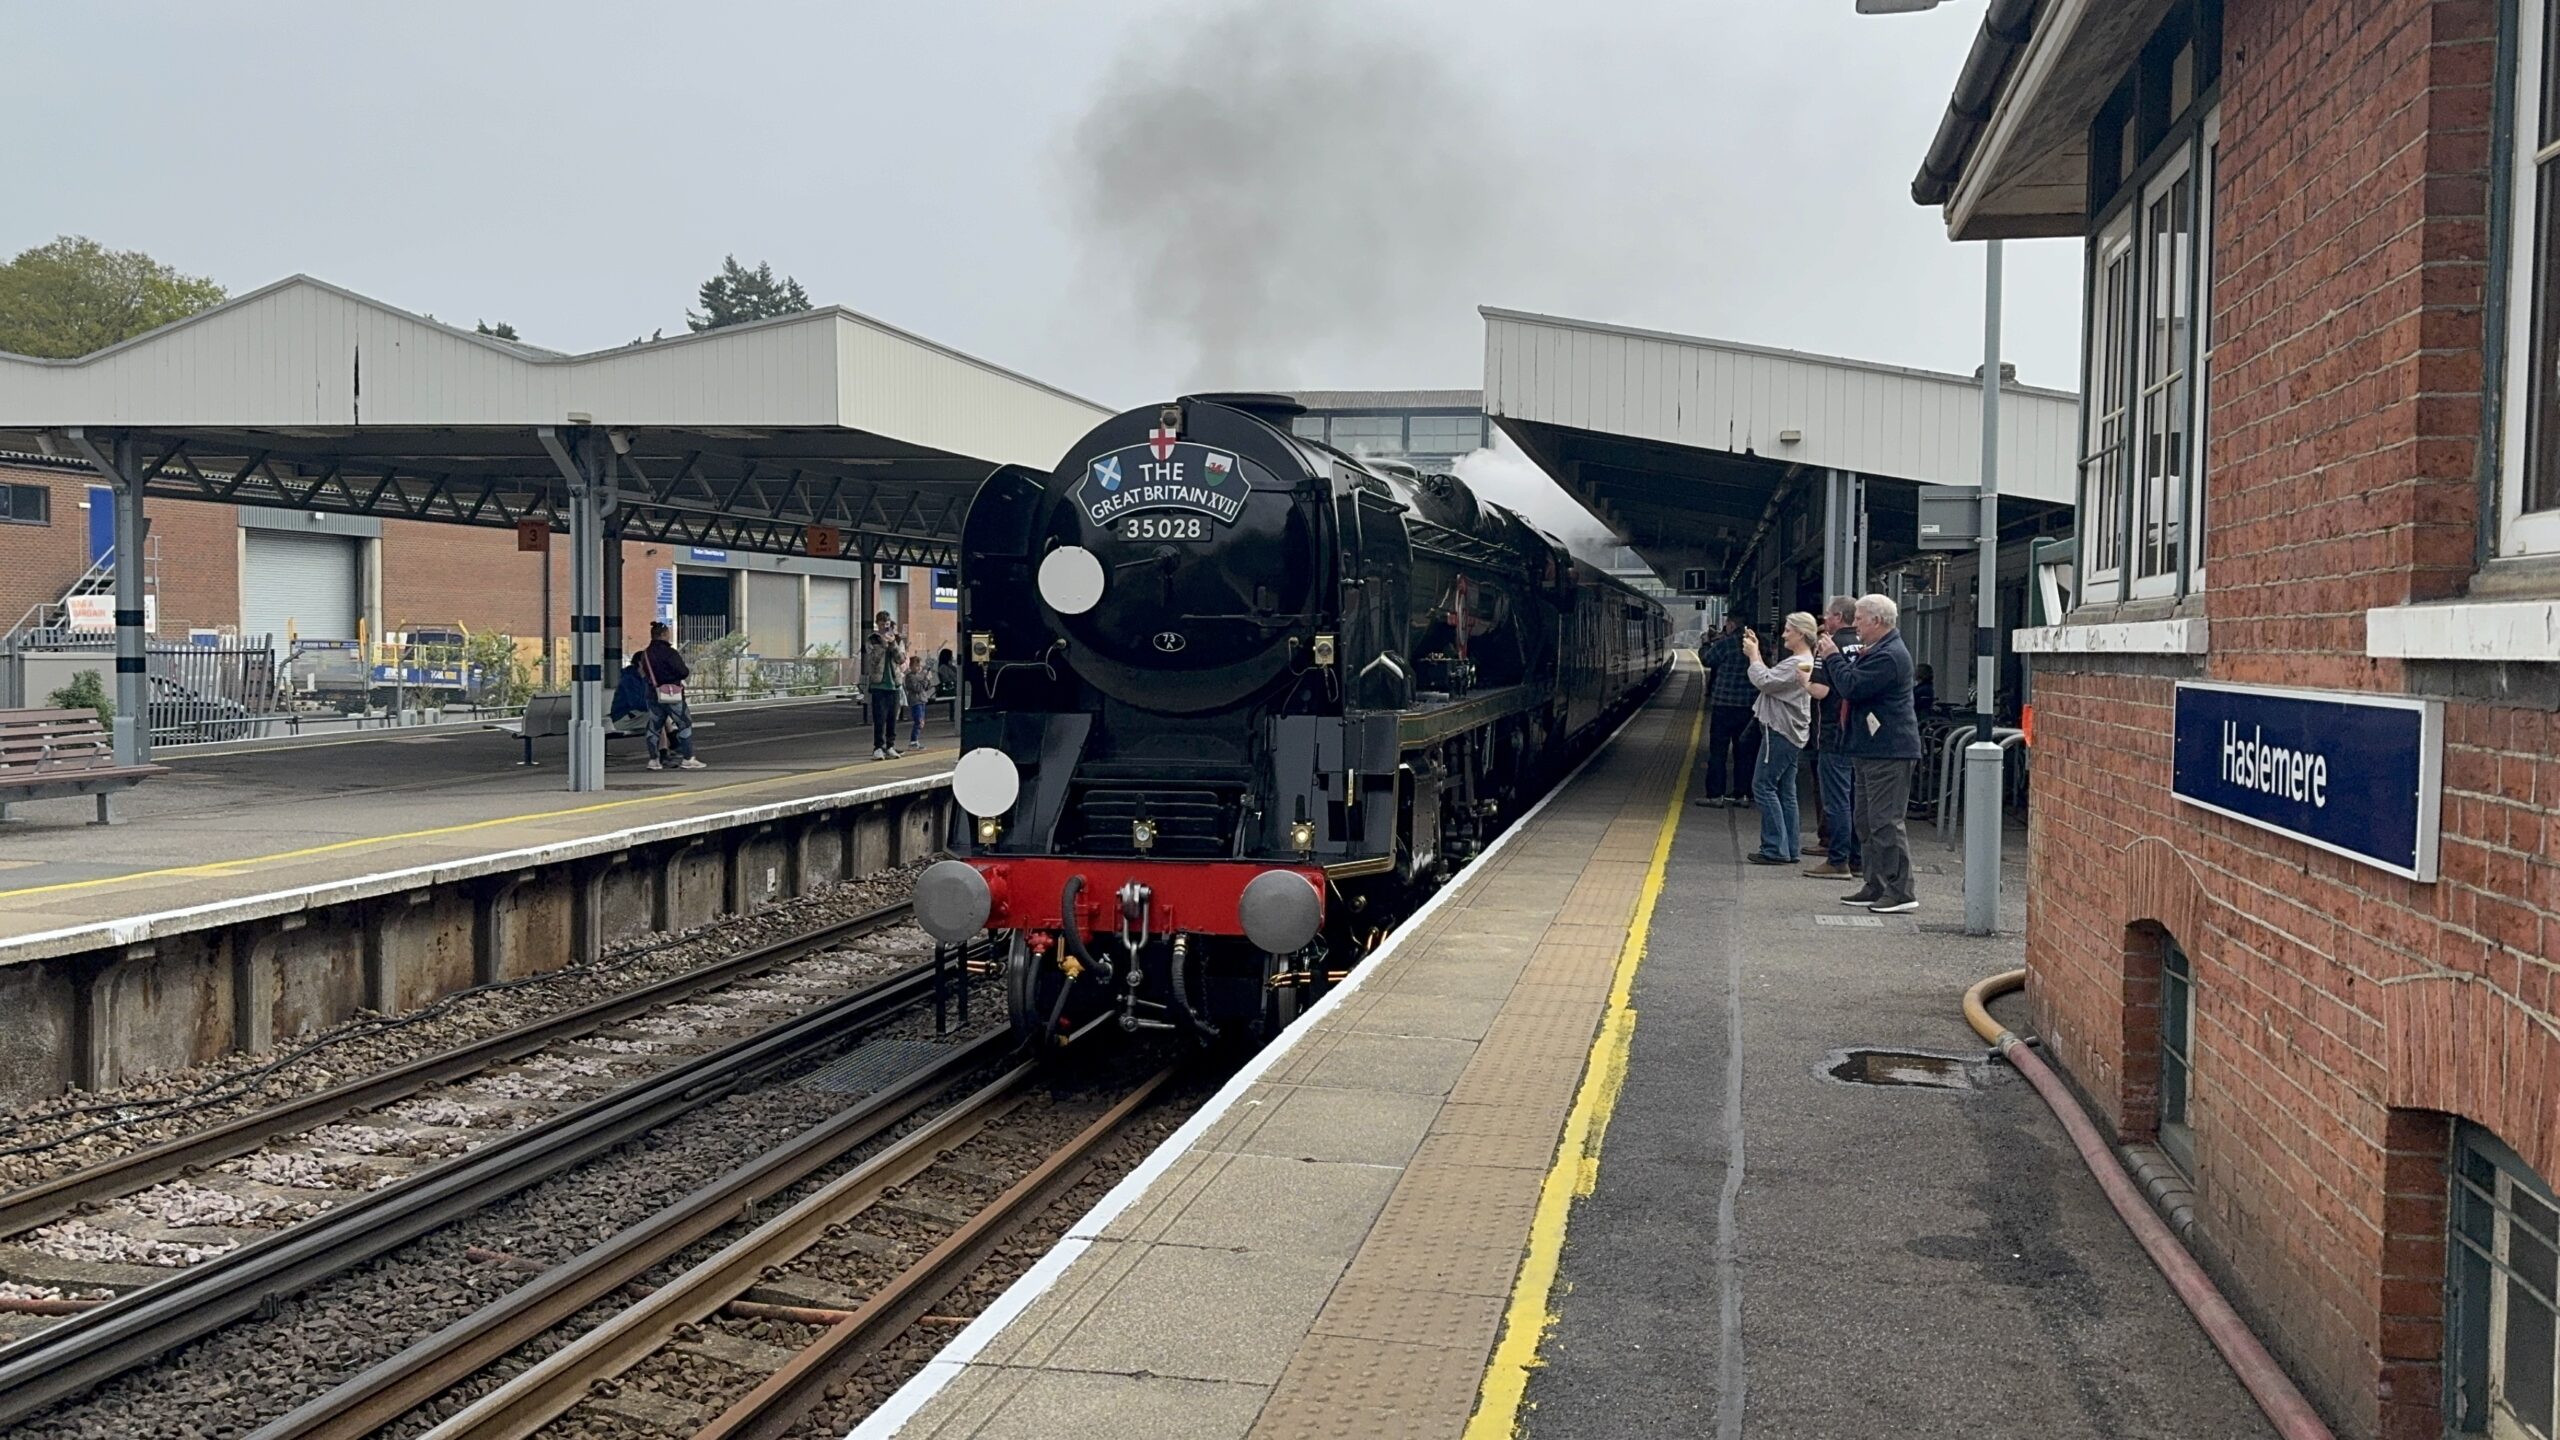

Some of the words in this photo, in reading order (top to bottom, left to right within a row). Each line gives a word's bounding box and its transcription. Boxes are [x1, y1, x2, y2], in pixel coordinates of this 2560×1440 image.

[1138, 462, 1184, 482] THE
[1091, 487, 1142, 519] GREAT
[1143, 485, 1209, 505] BRITAIN
[1207, 491, 1238, 516] XVII
[529, 528, 538, 542] 3
[1126, 518, 1201, 539] 35028
[819, 532, 828, 546] 2
[886, 564, 897, 578] 3
[1691, 571, 1699, 589] 1
[2222, 719, 2327, 808] Haslemere
